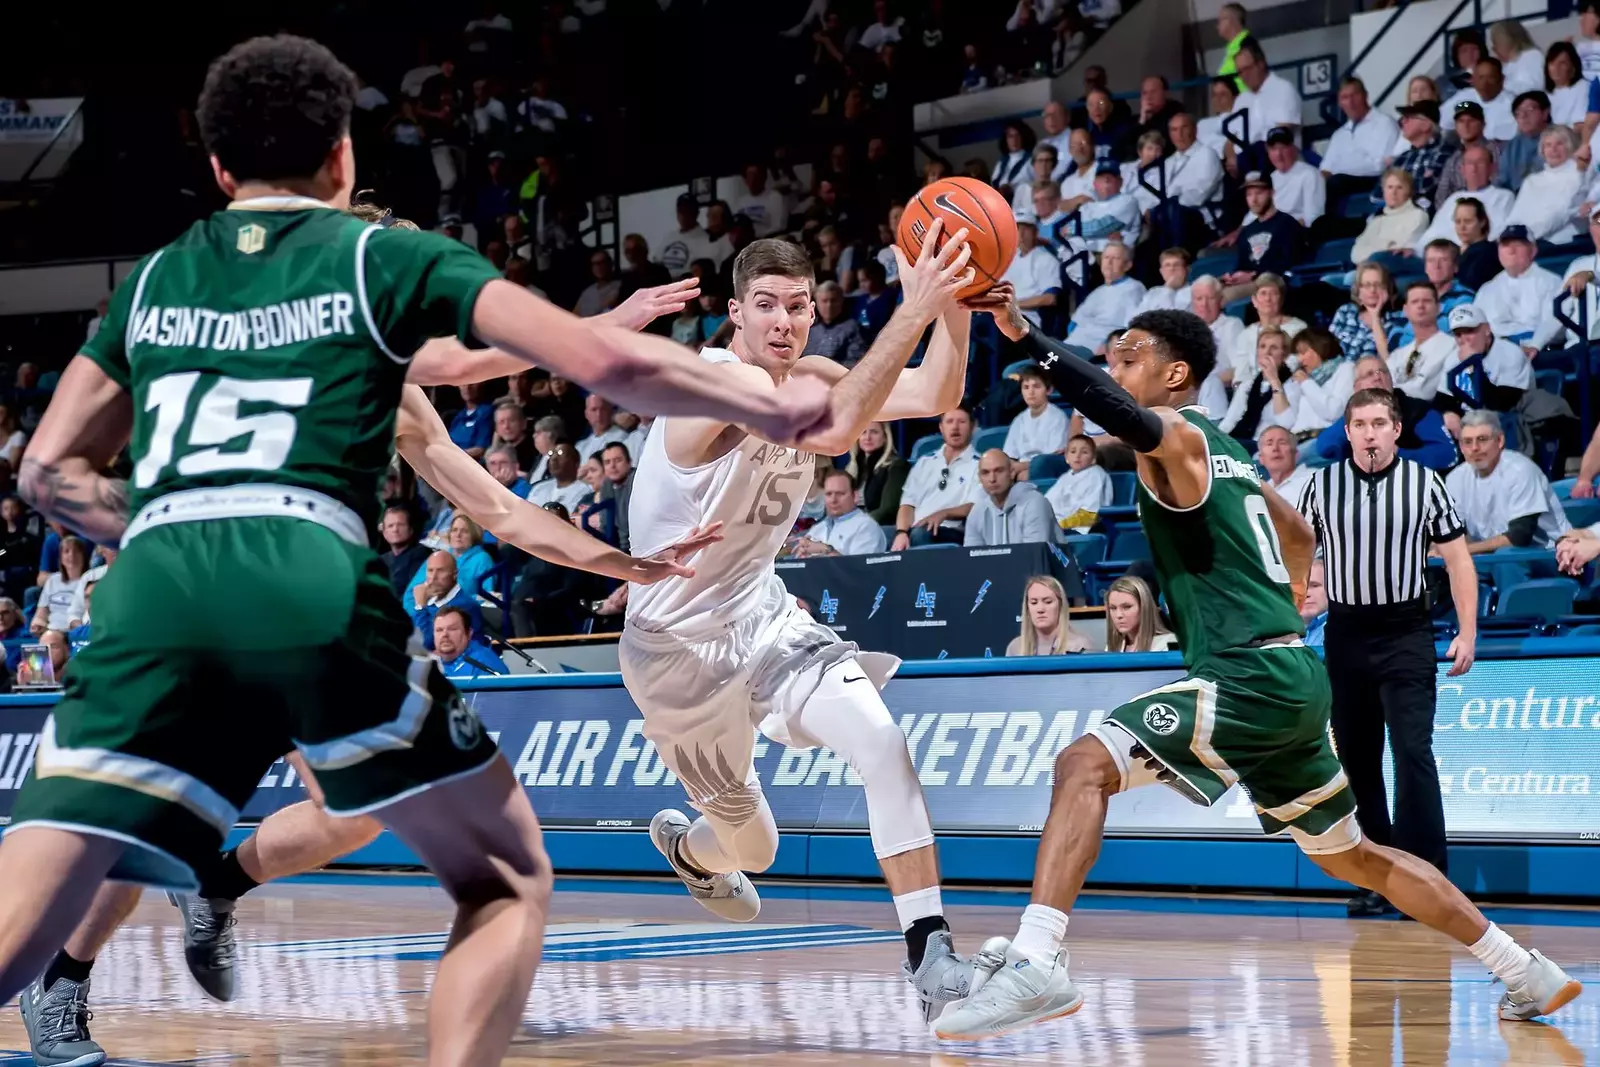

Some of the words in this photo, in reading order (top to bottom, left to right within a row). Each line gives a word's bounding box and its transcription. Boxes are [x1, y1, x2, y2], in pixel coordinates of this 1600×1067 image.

[1306, 63, 1328, 86] L3
[135, 371, 314, 489] 15
[745, 471, 803, 526] 15
[1244, 494, 1291, 584] 0
[513, 720, 611, 786] AIR
[771, 710, 1105, 786] BAKETBA
[1462, 767, 1591, 795] Centura
